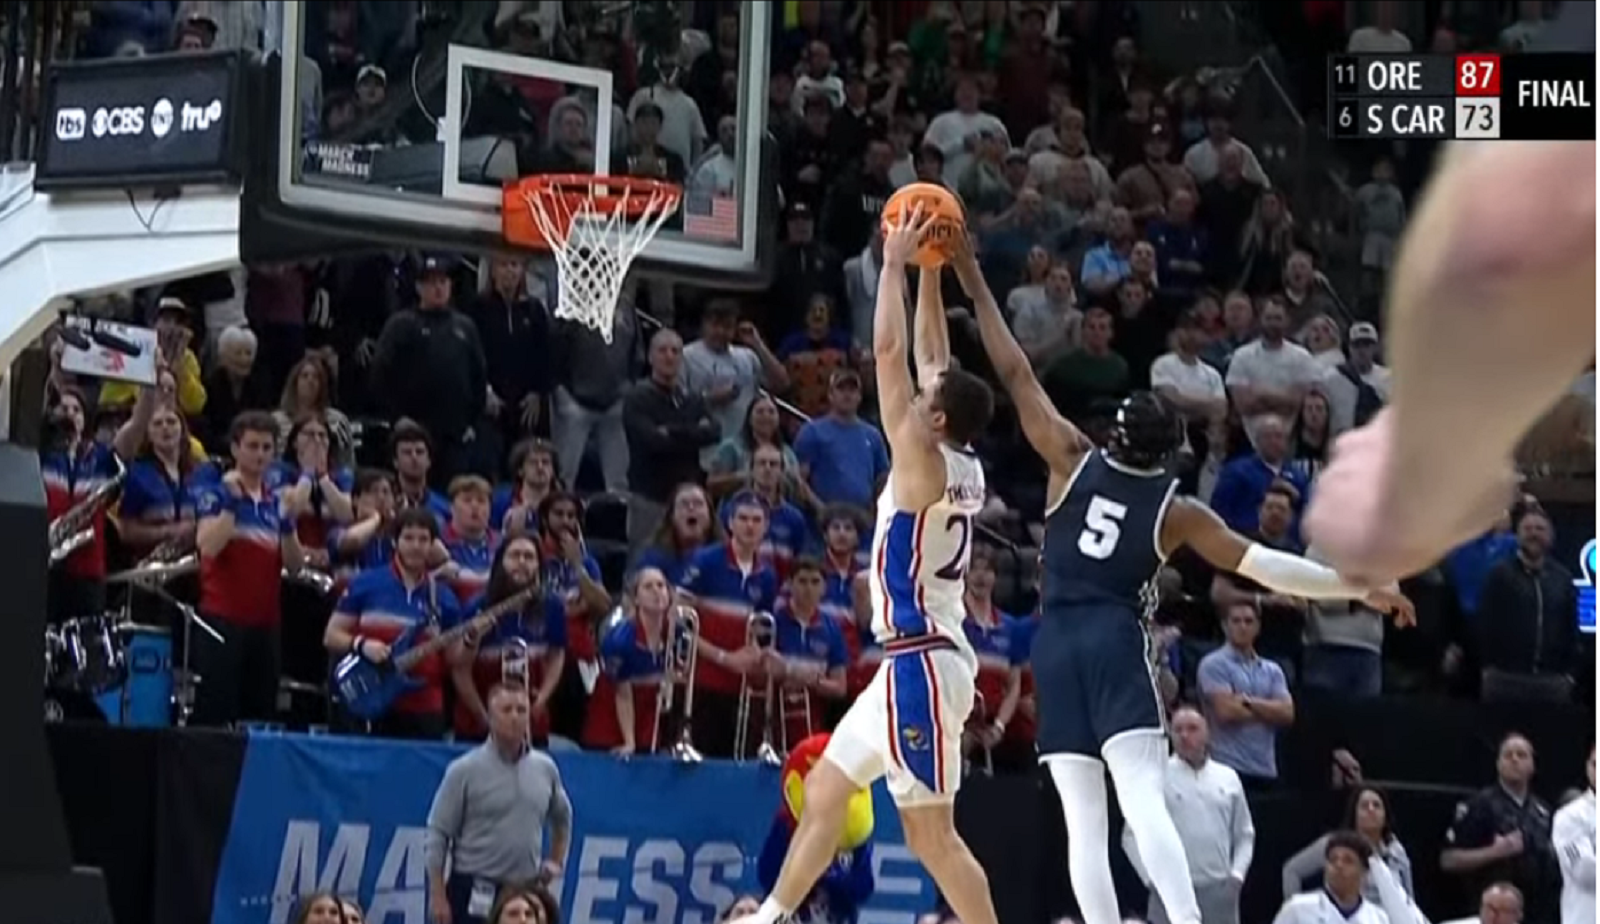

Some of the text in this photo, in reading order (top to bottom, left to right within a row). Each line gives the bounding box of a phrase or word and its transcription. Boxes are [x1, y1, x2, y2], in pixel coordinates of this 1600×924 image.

[108, 106, 145, 135] CBS
[1077, 494, 1128, 560] 5
[268, 820, 744, 924] MAESS
